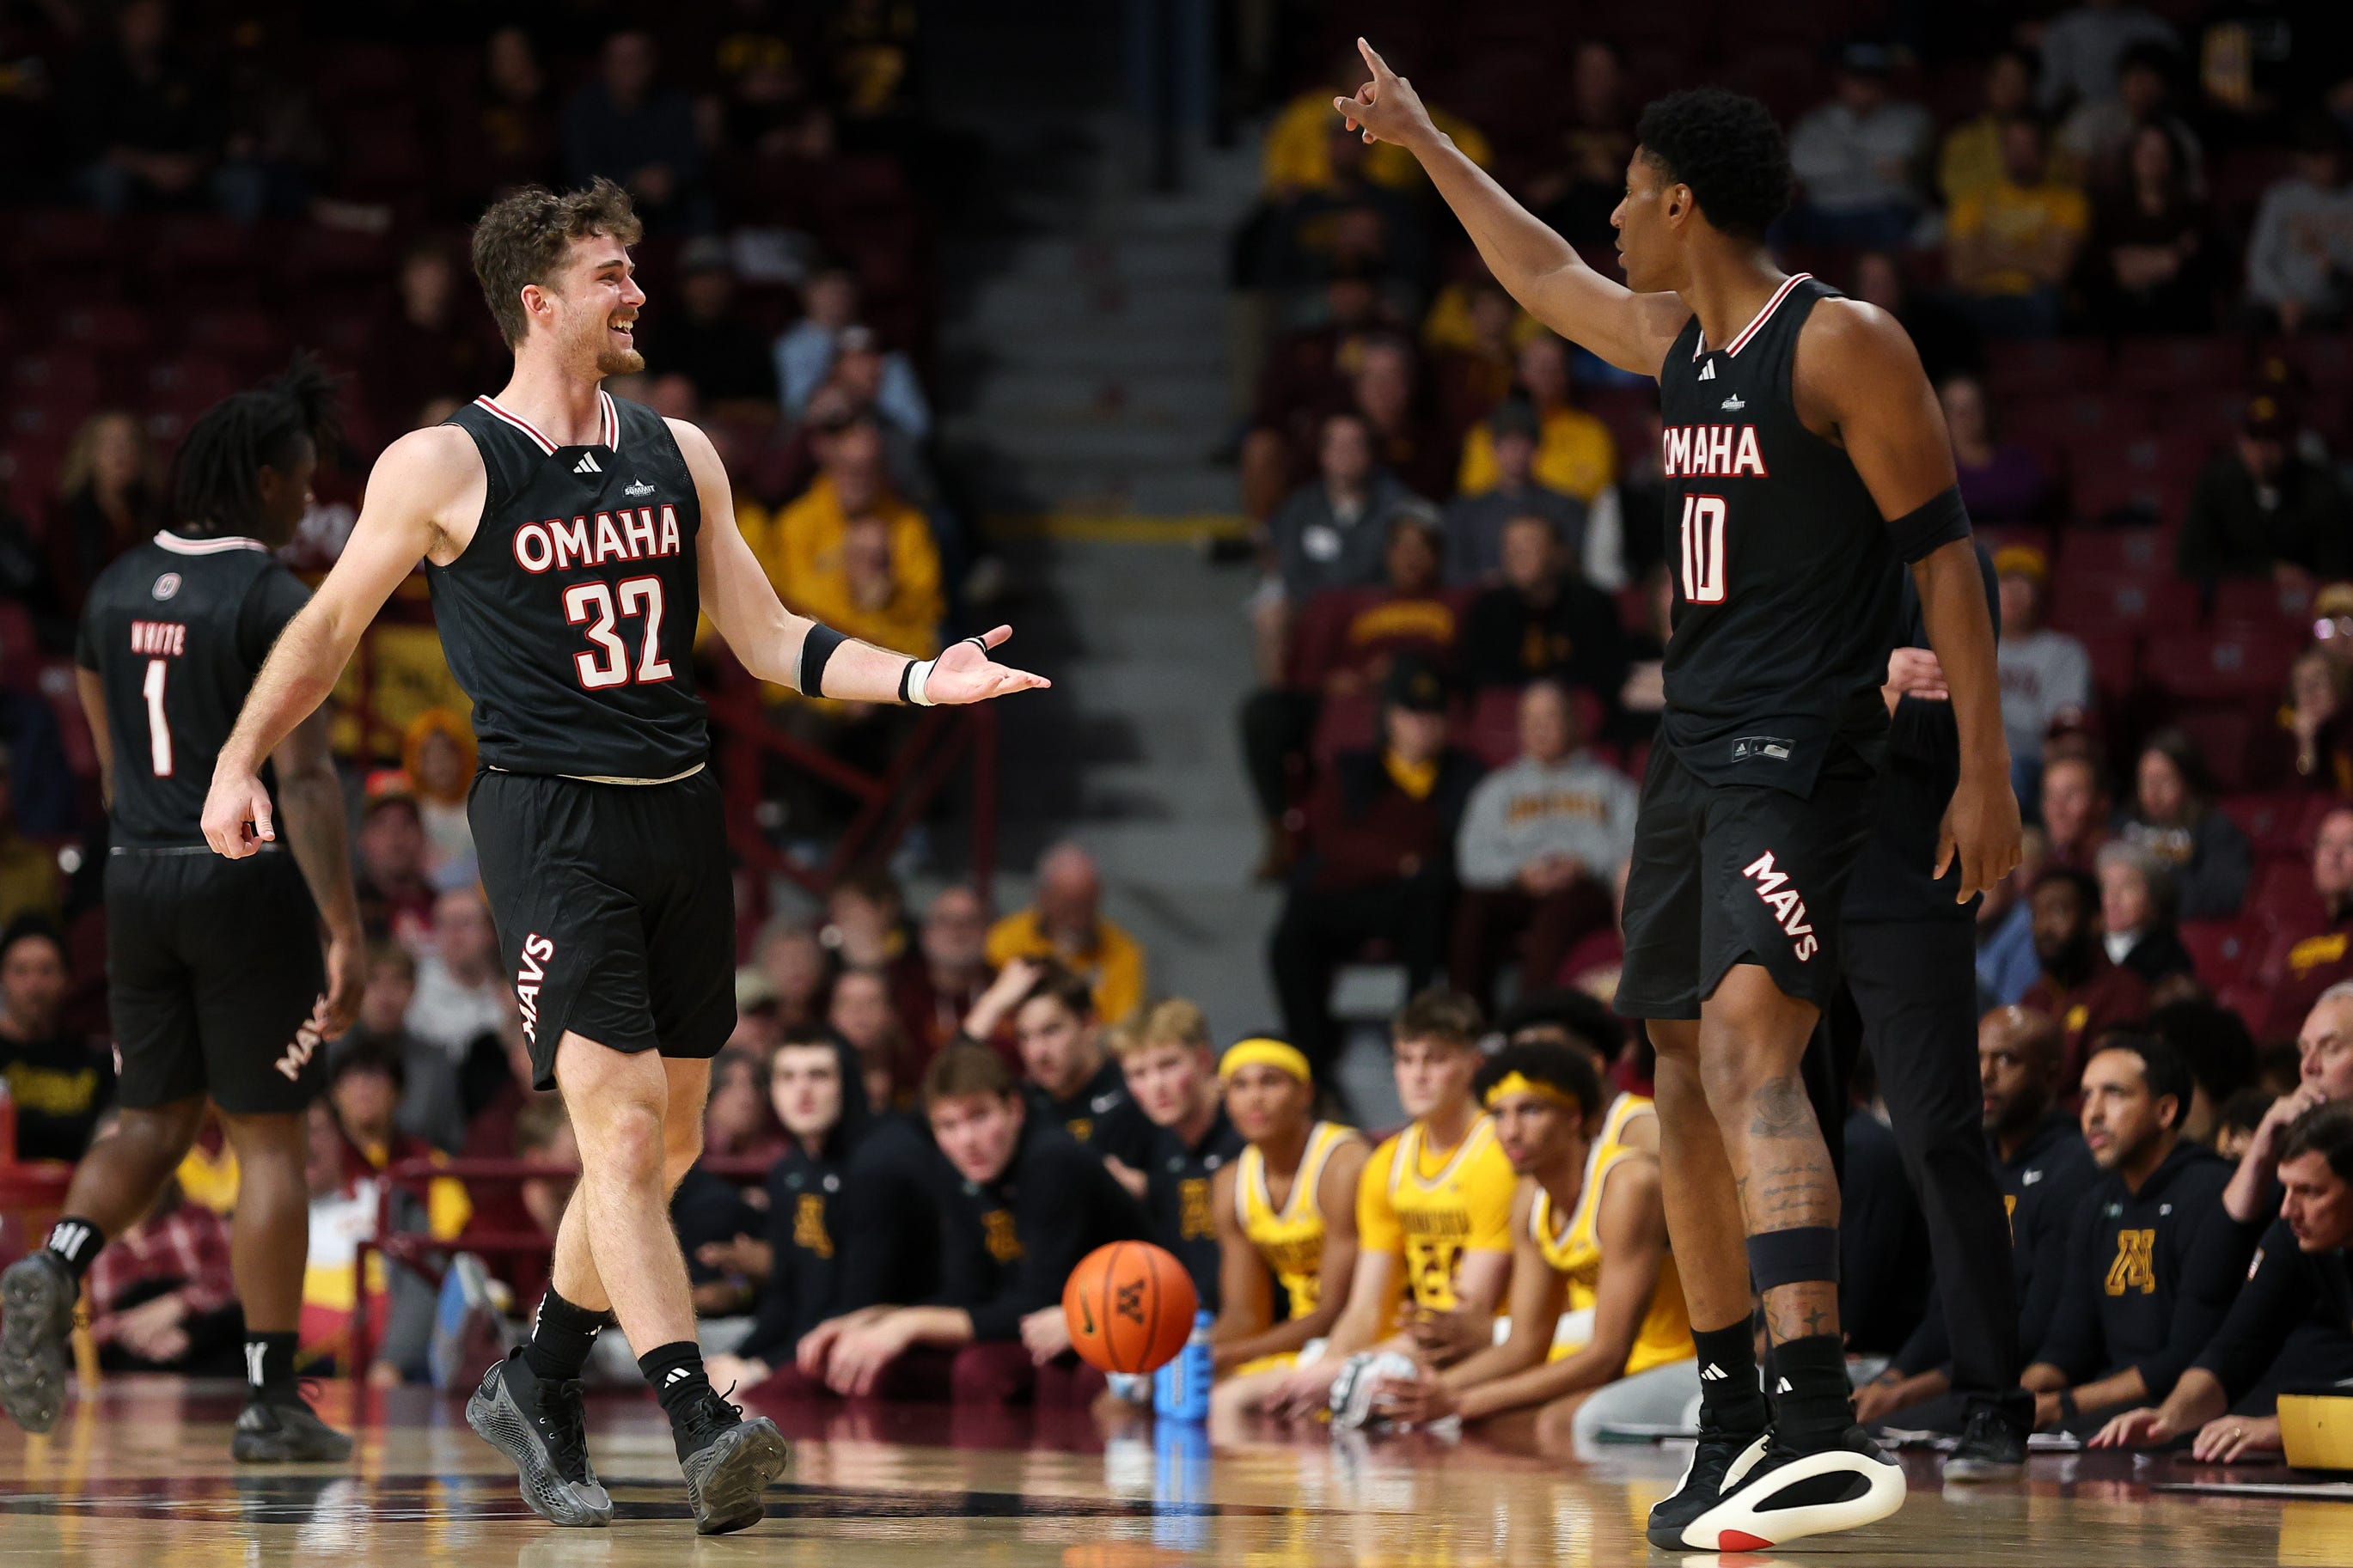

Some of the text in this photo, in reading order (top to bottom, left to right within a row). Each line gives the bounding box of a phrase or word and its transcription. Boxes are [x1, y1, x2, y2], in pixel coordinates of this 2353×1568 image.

[624, 484, 657, 497] SUMMIT
[1663, 424, 1769, 478] OMAHA
[513, 504, 680, 574] OMAHA
[1681, 493, 1728, 605] 10
[562, 575, 674, 691] 32
[144, 659, 174, 777] 1
[1741, 848, 1820, 962] MAVS
[516, 931, 555, 1046] MAVS
[2104, 1229, 2155, 1296] M
